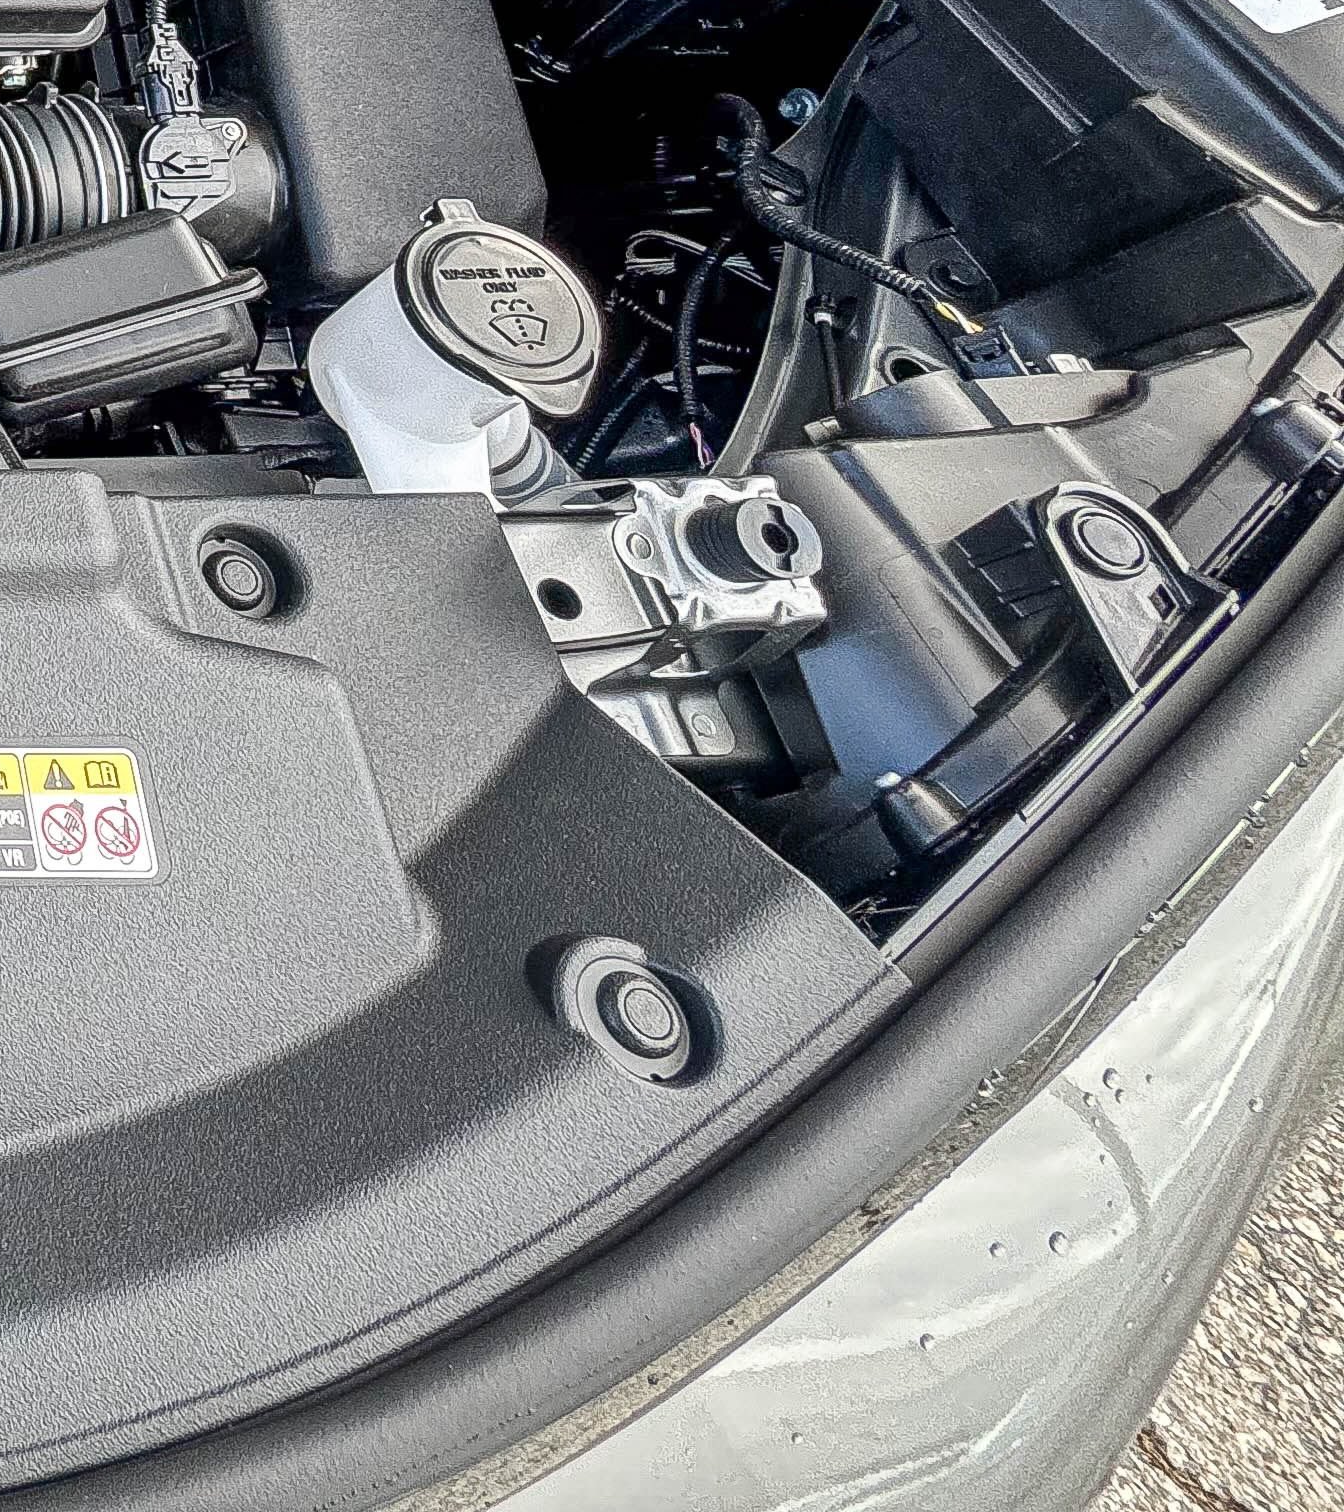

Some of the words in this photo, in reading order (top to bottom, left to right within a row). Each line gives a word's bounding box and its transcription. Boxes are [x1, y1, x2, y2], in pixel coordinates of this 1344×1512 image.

[439, 268, 502, 280] WASHER
[505, 267, 547, 279] FLUID
[482, 282, 518, 293] ONLY
[1, 848, 26, 867] VR
